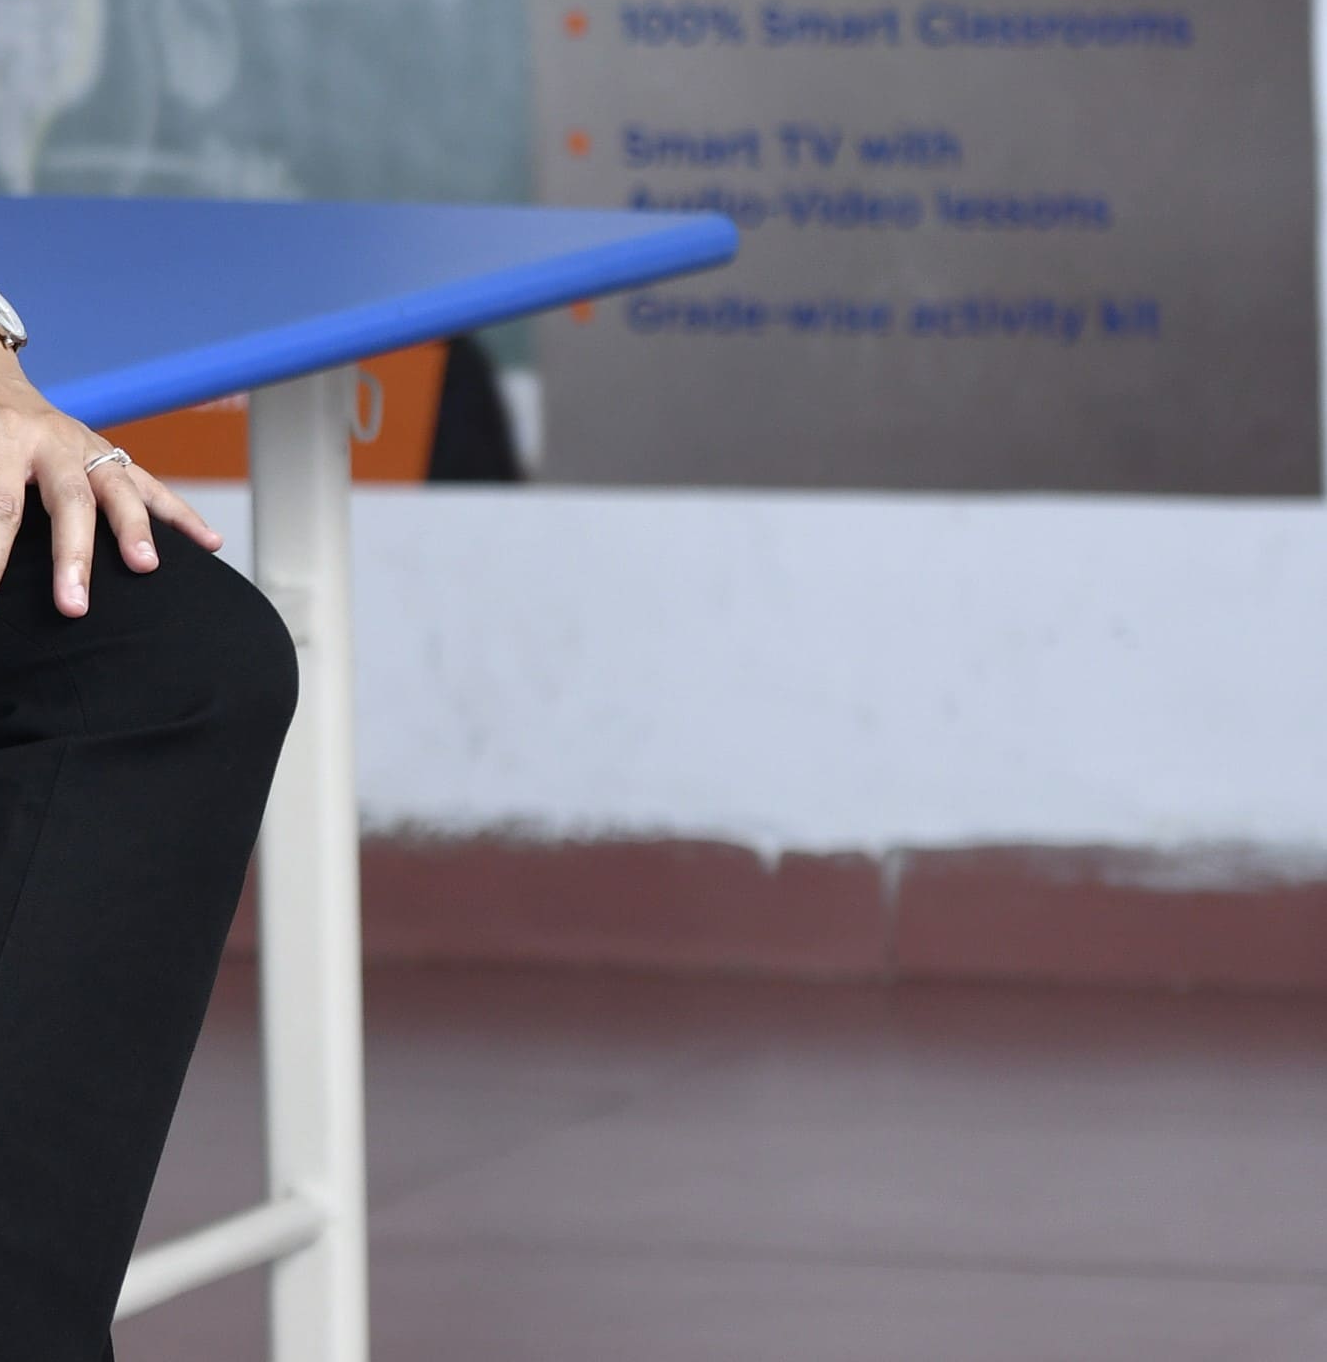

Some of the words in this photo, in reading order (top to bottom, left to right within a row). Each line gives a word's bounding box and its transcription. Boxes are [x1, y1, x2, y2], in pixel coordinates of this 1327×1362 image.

[621, 0, 742, 46] 100%
[759, 0, 899, 45] Smart
[915, 0, 1195, 46] Classrooms
[623, 124, 760, 166] Smart
[776, 124, 845, 162] TV
[858, 124, 961, 164] with
[936, 187, 1109, 229] lessons
[627, 293, 890, 333] Grade-wise
[911, 291, 1085, 343] activity
[1101, 294, 1161, 337] kit
